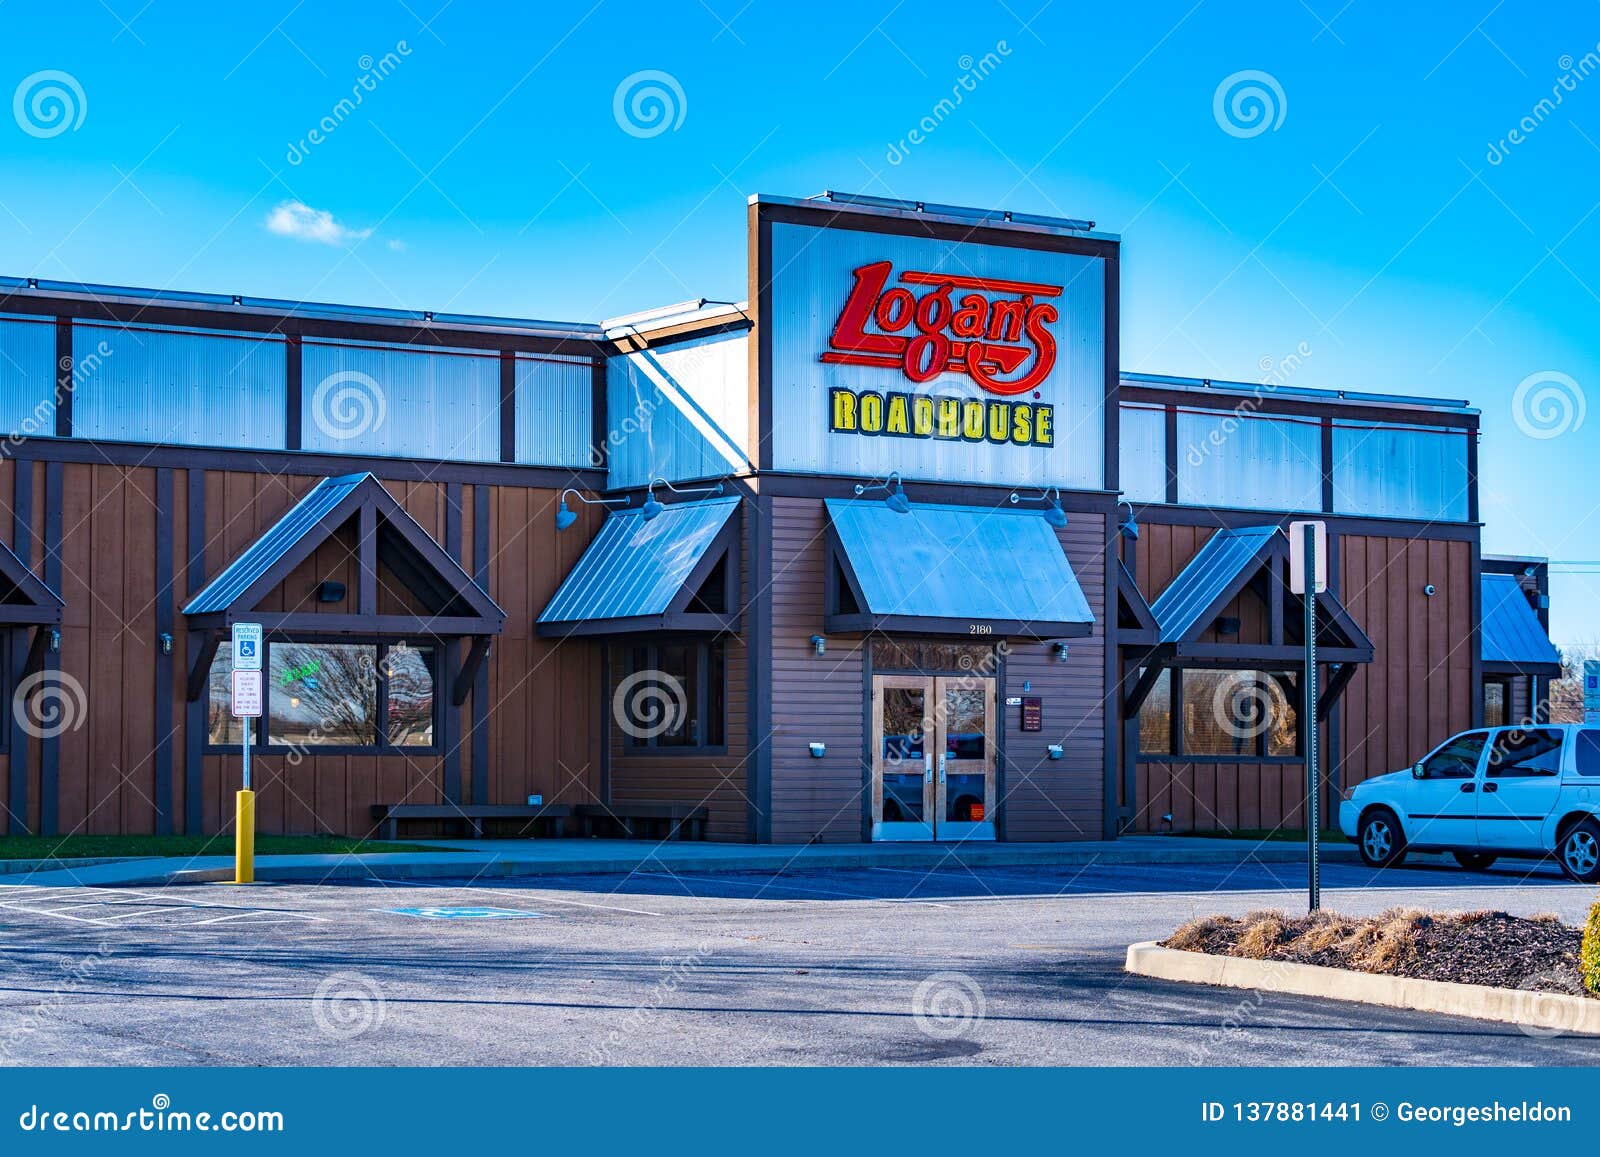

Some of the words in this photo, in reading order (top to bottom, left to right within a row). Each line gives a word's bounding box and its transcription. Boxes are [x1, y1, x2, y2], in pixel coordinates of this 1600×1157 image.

[824, 260, 1060, 396] Logan's
[831, 389, 1054, 446] ROADHOUSE
[969, 624, 992, 635] 2180
